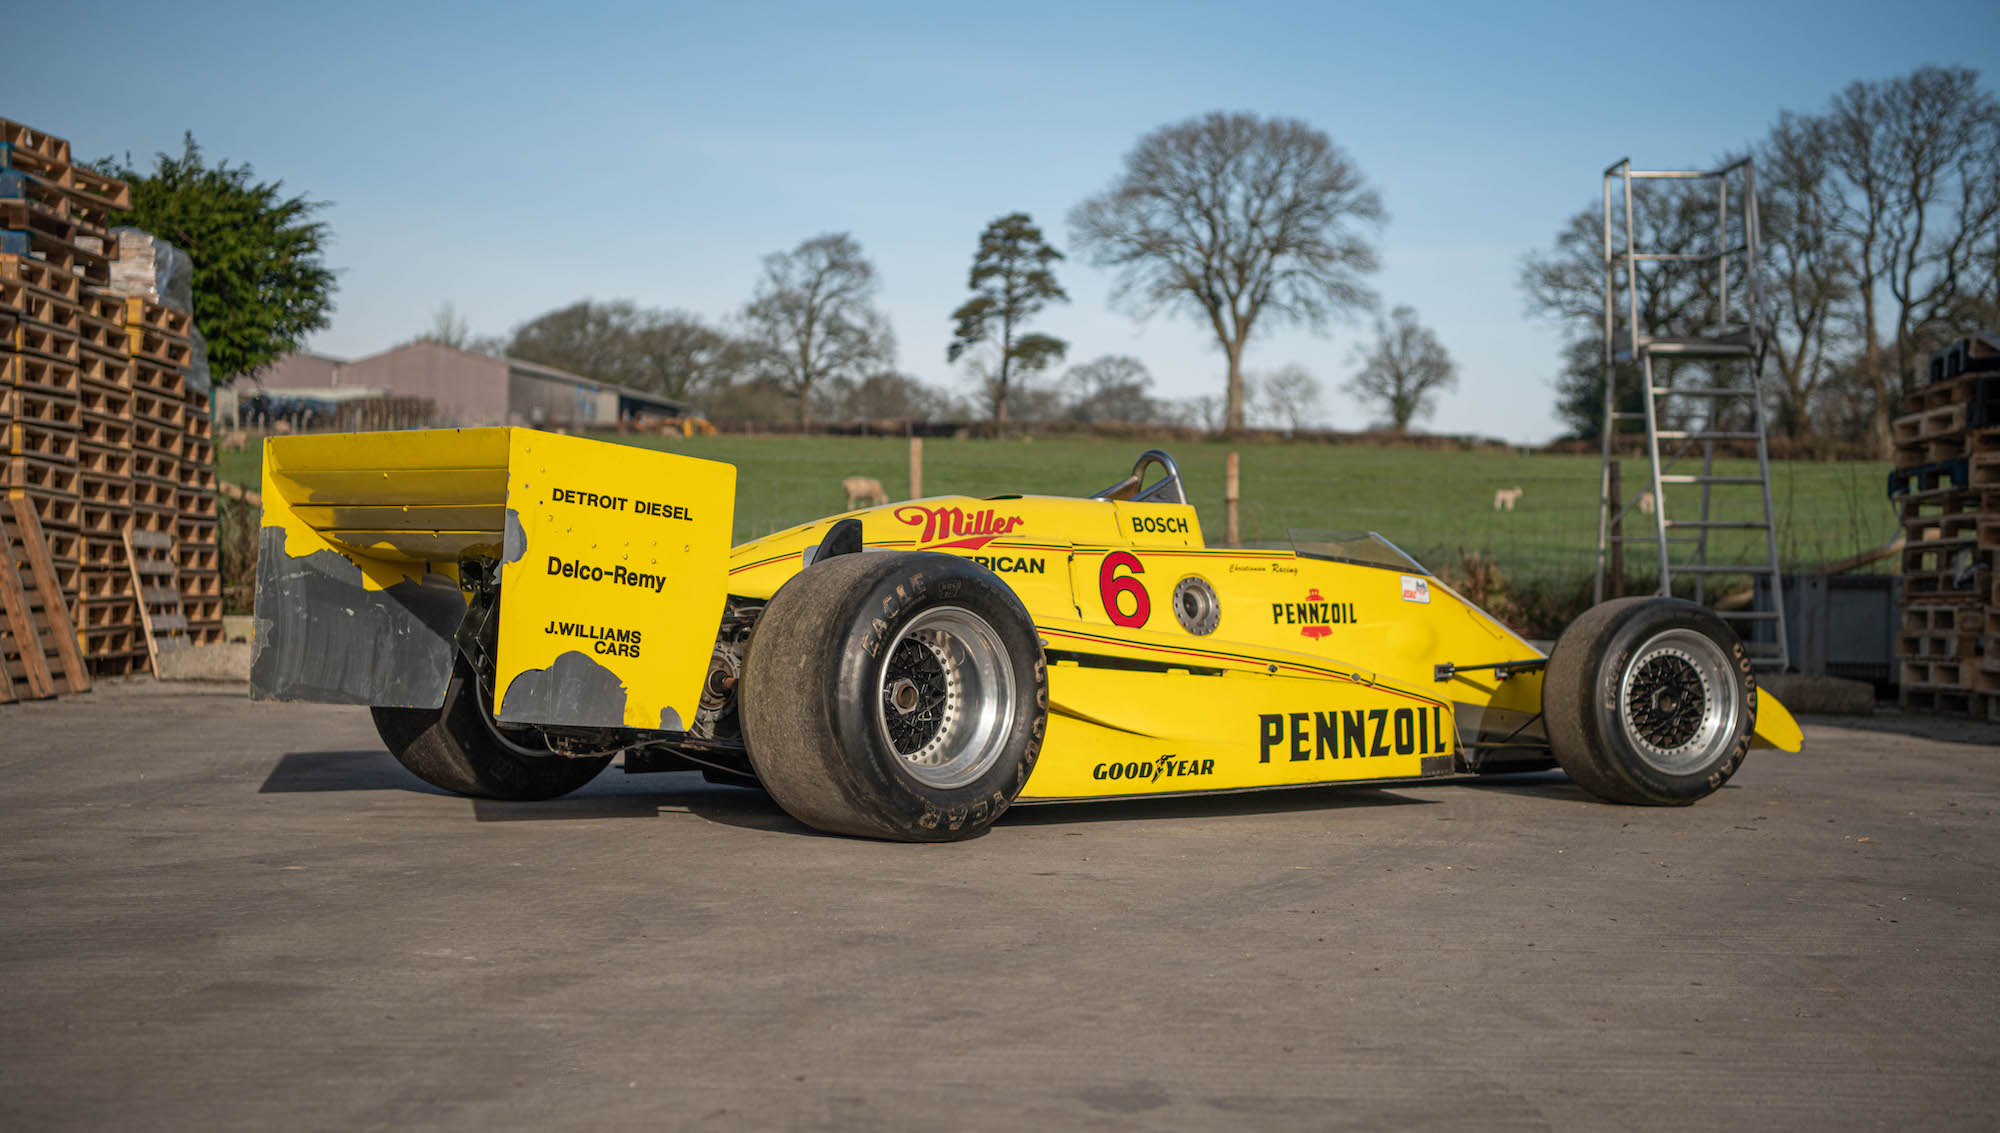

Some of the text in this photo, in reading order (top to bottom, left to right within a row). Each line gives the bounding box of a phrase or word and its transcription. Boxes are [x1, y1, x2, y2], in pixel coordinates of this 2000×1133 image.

[552, 487, 693, 522] DETROIT DIESEL
[893, 505, 1025, 543] Miller
[1131, 516, 1190, 534] BOSCH
[547, 555, 667, 594] Delco-Remy
[967, 556, 1046, 574] RICAN
[1099, 550, 1152, 629] 6
[1272, 602, 1358, 625] PENNZOIL
[544, 620, 642, 645] J.WILLIAMS
[593, 640, 641, 659] CARS
[1258, 706, 1447, 764] PENNZOIL
[1092, 754, 1216, 783] GOODYEAR
